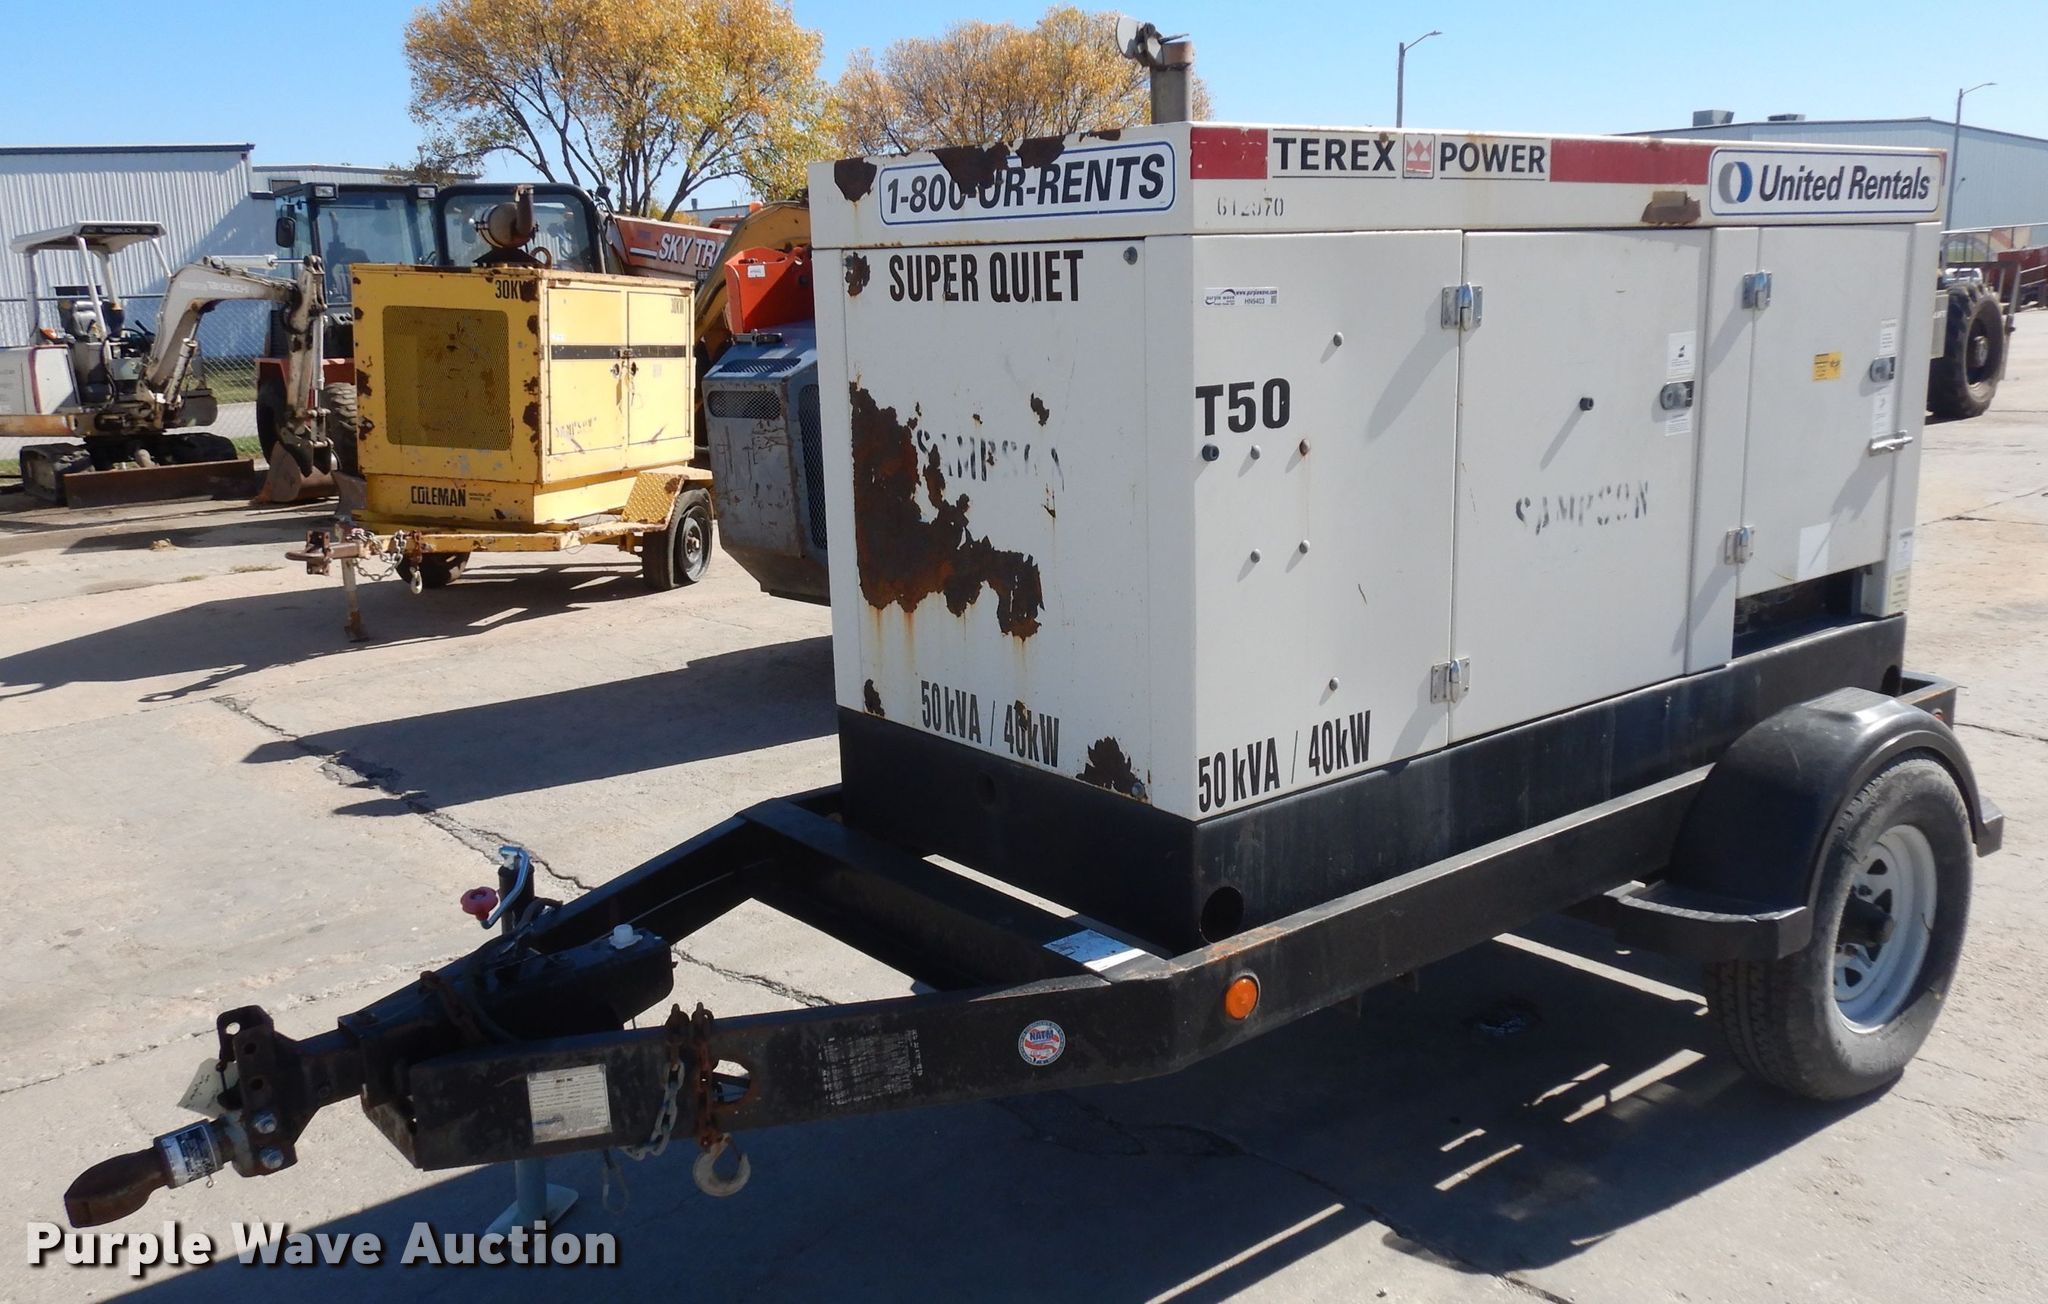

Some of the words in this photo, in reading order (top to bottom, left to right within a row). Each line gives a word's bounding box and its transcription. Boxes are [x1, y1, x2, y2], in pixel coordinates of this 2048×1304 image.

[1273, 137, 1396, 172] TEREX
[1440, 142, 1546, 174] POWER
[1759, 164, 1846, 201] United
[1848, 165, 1931, 200] Rentals
[659, 233, 693, 262] SKY
[495, 280, 529, 300] 30K
[889, 254, 979, 302] SUPER
[989, 250, 1084, 303] QUIET
[1195, 377, 1290, 436] T50
[411, 486, 466, 507] COLEMAN
[1198, 751, 1227, 813] 50
[1232, 737, 1281, 802] kVA
[1308, 709, 1371, 777] 40kW
